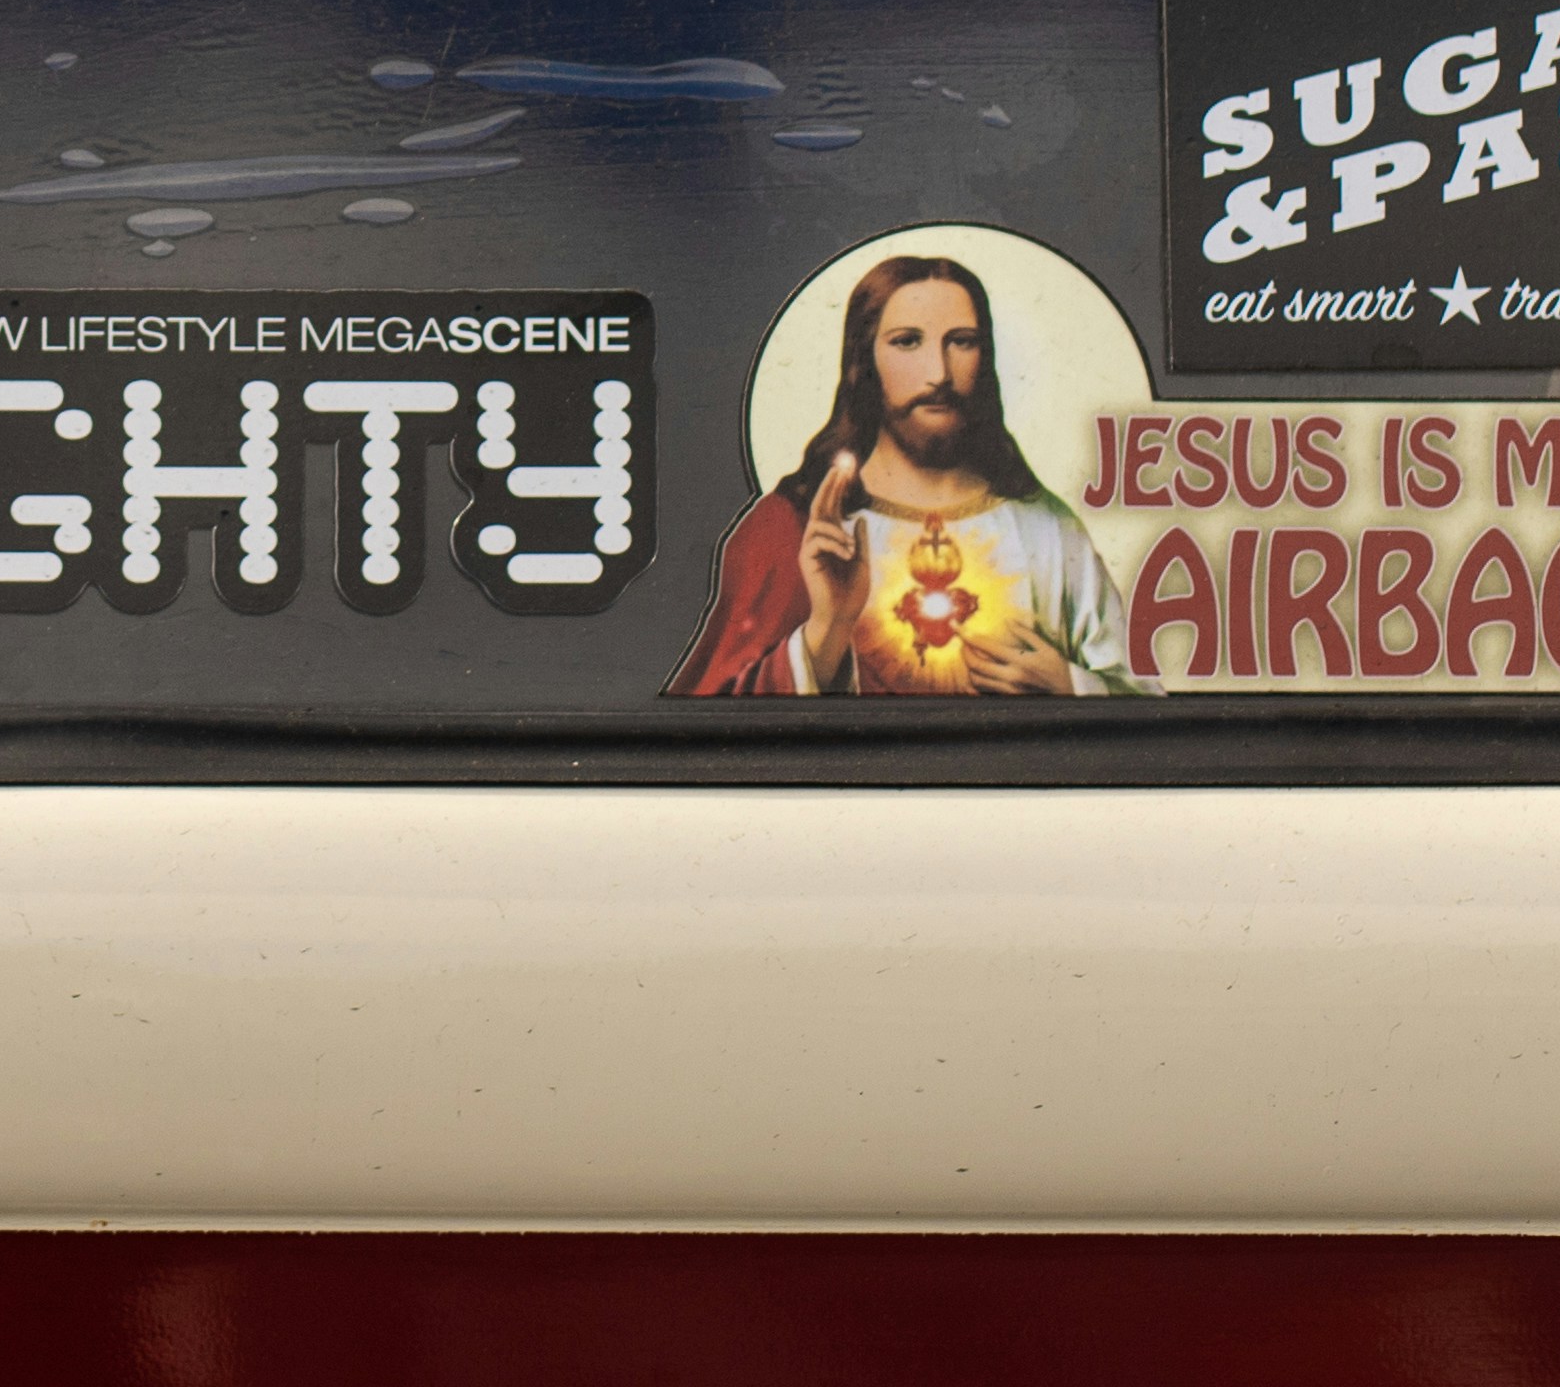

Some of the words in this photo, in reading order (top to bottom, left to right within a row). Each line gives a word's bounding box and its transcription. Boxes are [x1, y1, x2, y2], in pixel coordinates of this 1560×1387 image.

[1205, 280, 1277, 323] eat
[1283, 278, 1417, 322] smart
[41, 316, 286, 353] LIFESTYLE
[300, 316, 631, 354] MEGASCENE
[1083, 415, 1347, 510] JESUS
[1382, 416, 1461, 508] IS
